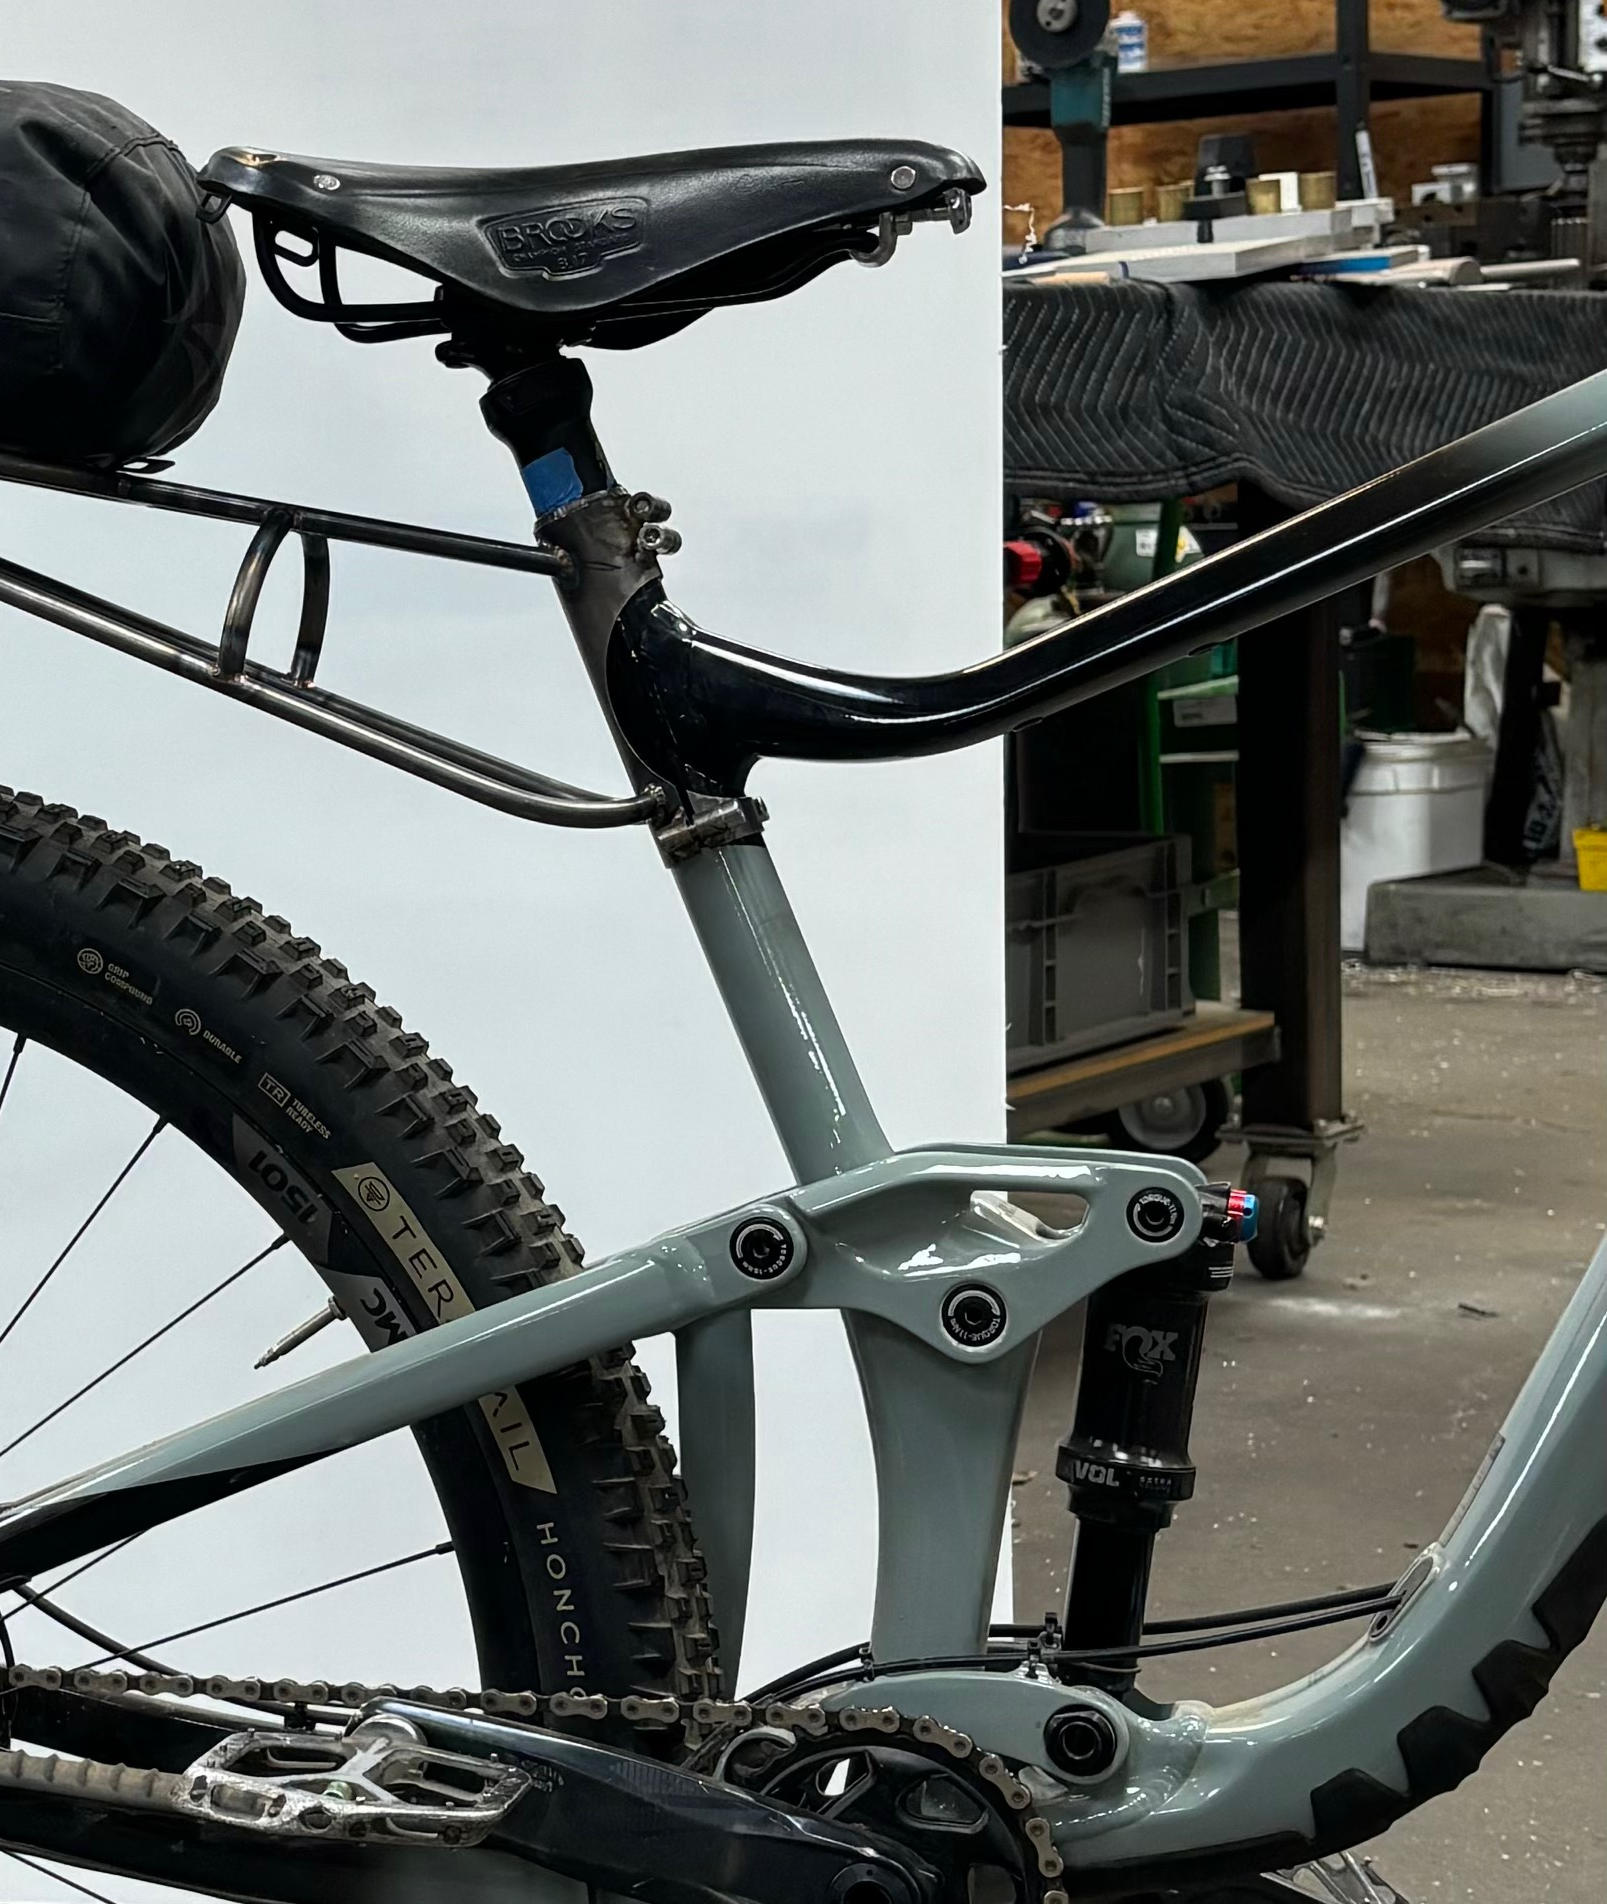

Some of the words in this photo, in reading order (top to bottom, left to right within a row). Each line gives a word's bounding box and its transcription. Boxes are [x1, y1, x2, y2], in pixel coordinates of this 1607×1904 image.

[497, 207, 637, 253] BROOKS
[107, 963, 130, 979] GRIP
[202, 1030, 243, 1065] DURABLE
[261, 1076, 288, 1104] TR
[285, 1106, 314, 1134] READY
[291, 1098, 332, 1140] TUBELESS
[1103, 1323, 1179, 1374] FOX
